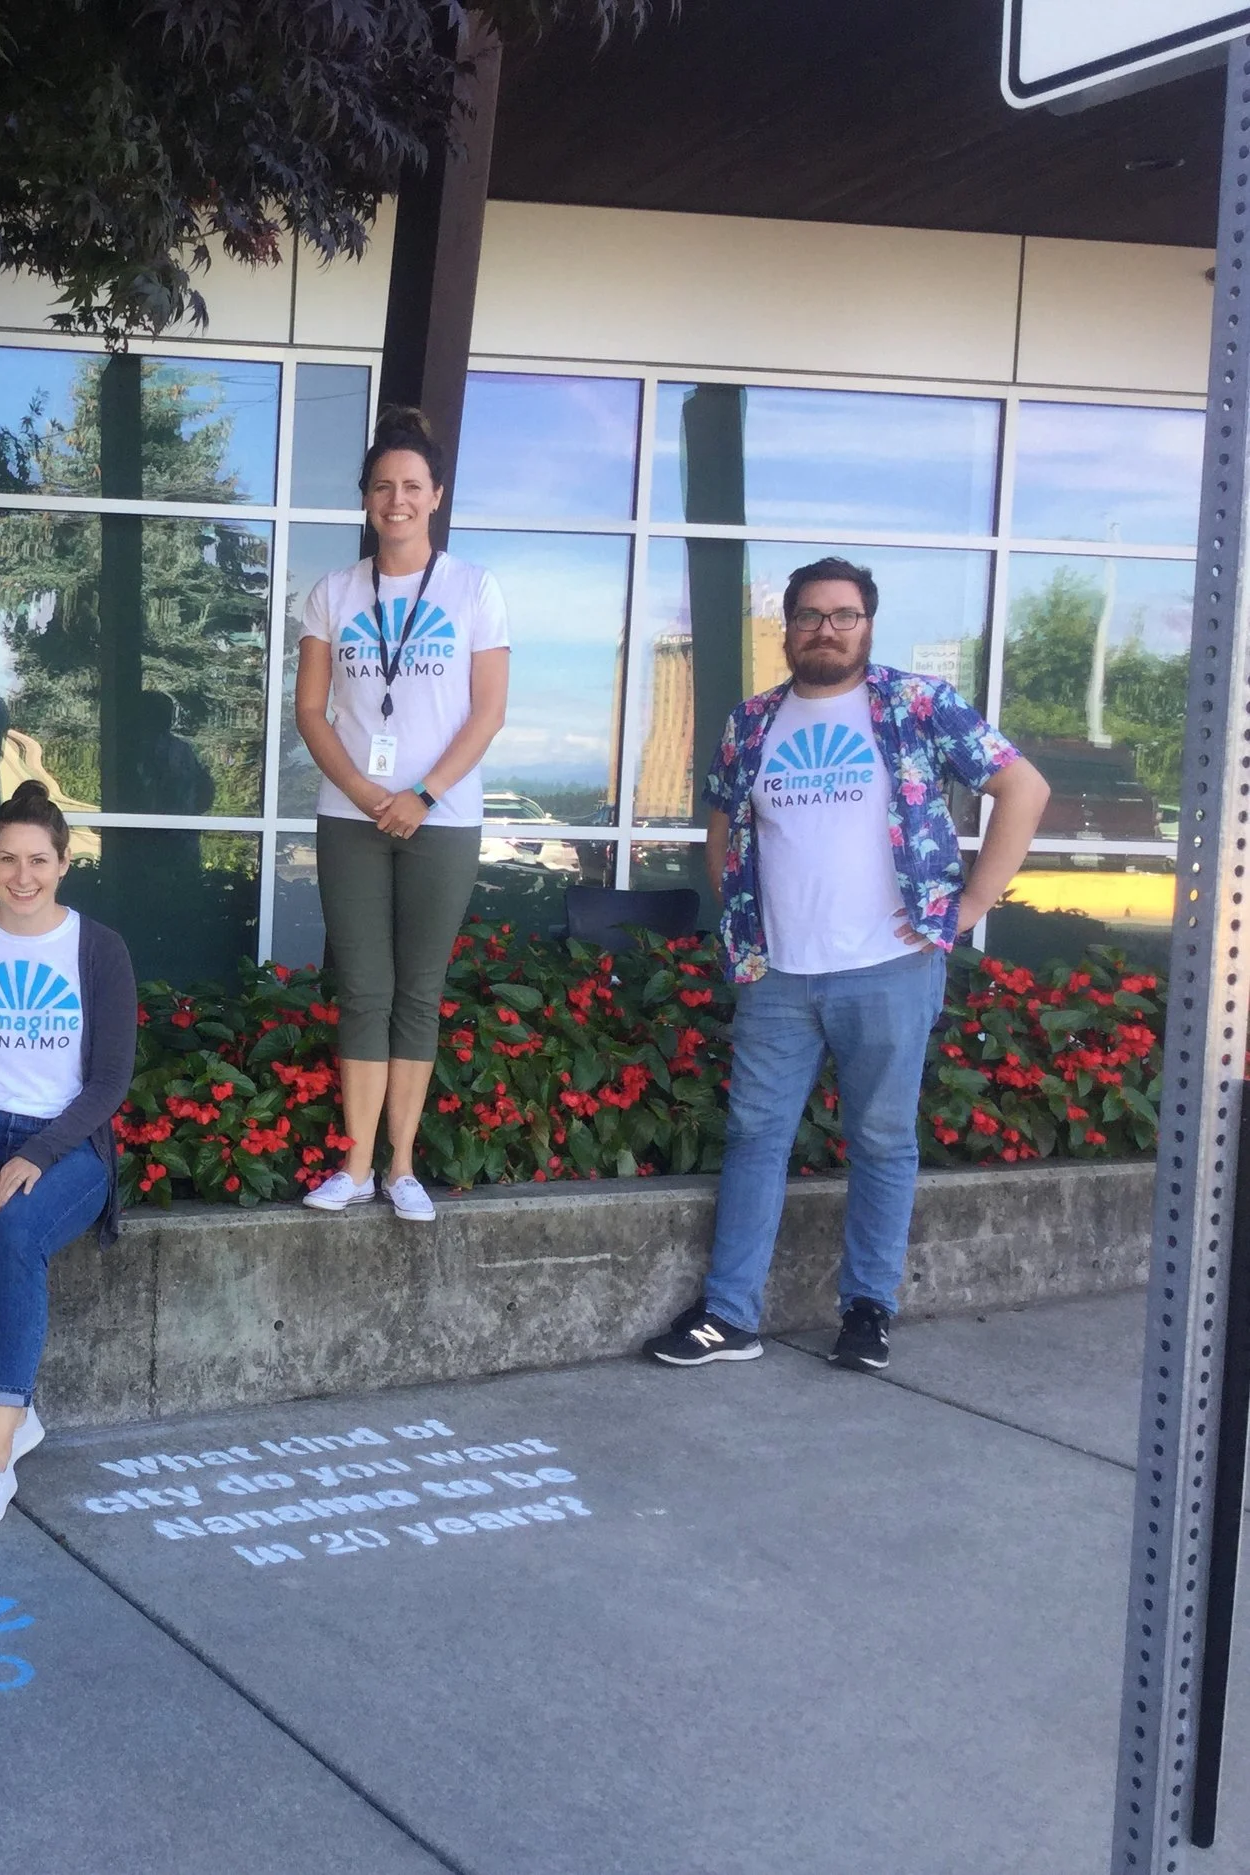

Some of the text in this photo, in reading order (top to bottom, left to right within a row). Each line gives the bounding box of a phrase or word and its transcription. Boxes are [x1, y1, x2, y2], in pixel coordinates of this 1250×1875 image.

[346, 663, 445, 678] NANAIMO
[763, 767, 874, 795] reimagine
[771, 789, 864, 808] NANAIMO
[690, 1324, 725, 1348] N
[99, 1418, 456, 1478] What kind of
[85, 1438, 559, 1514] city do you want
[153, 1467, 579, 1540] Nanaimo to be
[232, 1495, 592, 1566] in 20 years?
